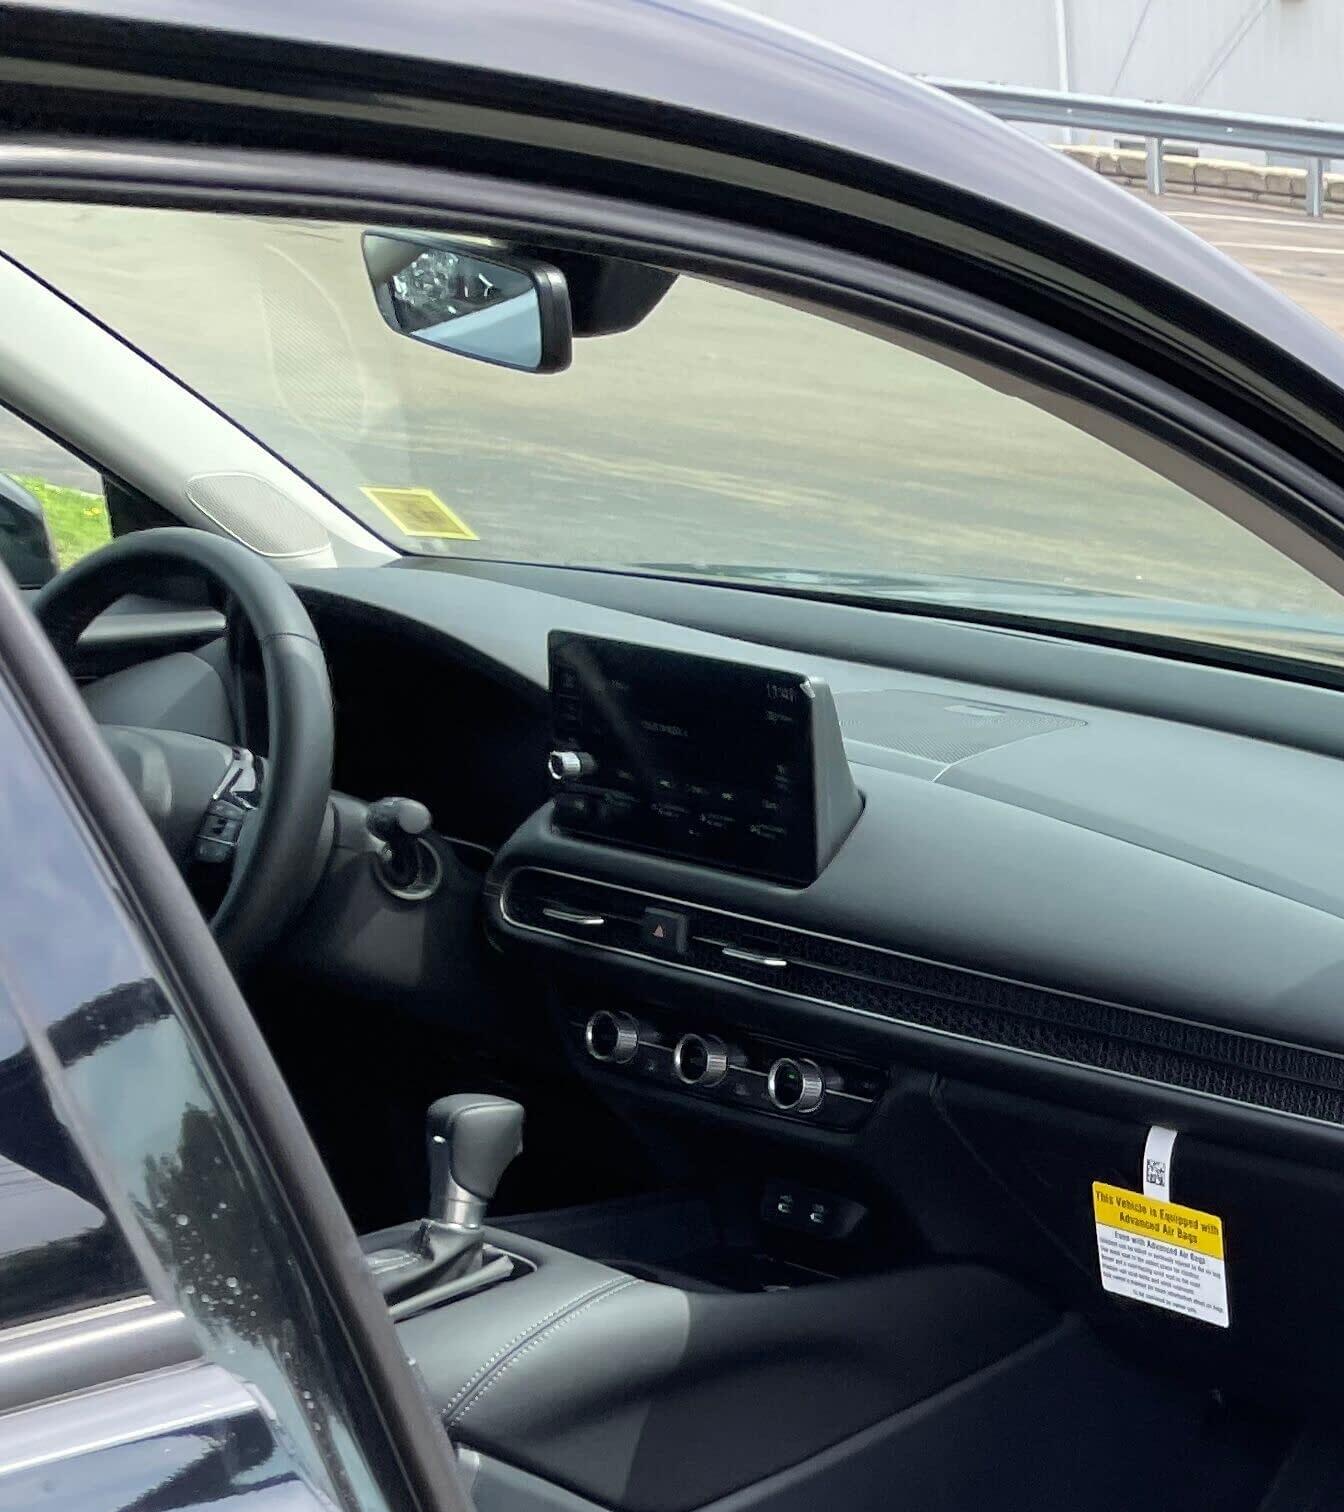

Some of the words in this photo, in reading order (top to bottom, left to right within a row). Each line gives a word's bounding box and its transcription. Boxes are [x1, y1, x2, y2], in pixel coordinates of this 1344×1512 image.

[1096, 1191, 1114, 1206] This
[1115, 1195, 1148, 1216] Vehicle
[1149, 1206, 1158, 1218] is
[1159, 1208, 1199, 1230] Equipped
[1201, 1222, 1220, 1236] with
[1119, 1211, 1161, 1233] Advanced
[1162, 1223, 1175, 1236] Air
[1177, 1227, 1198, 1245] Bags
